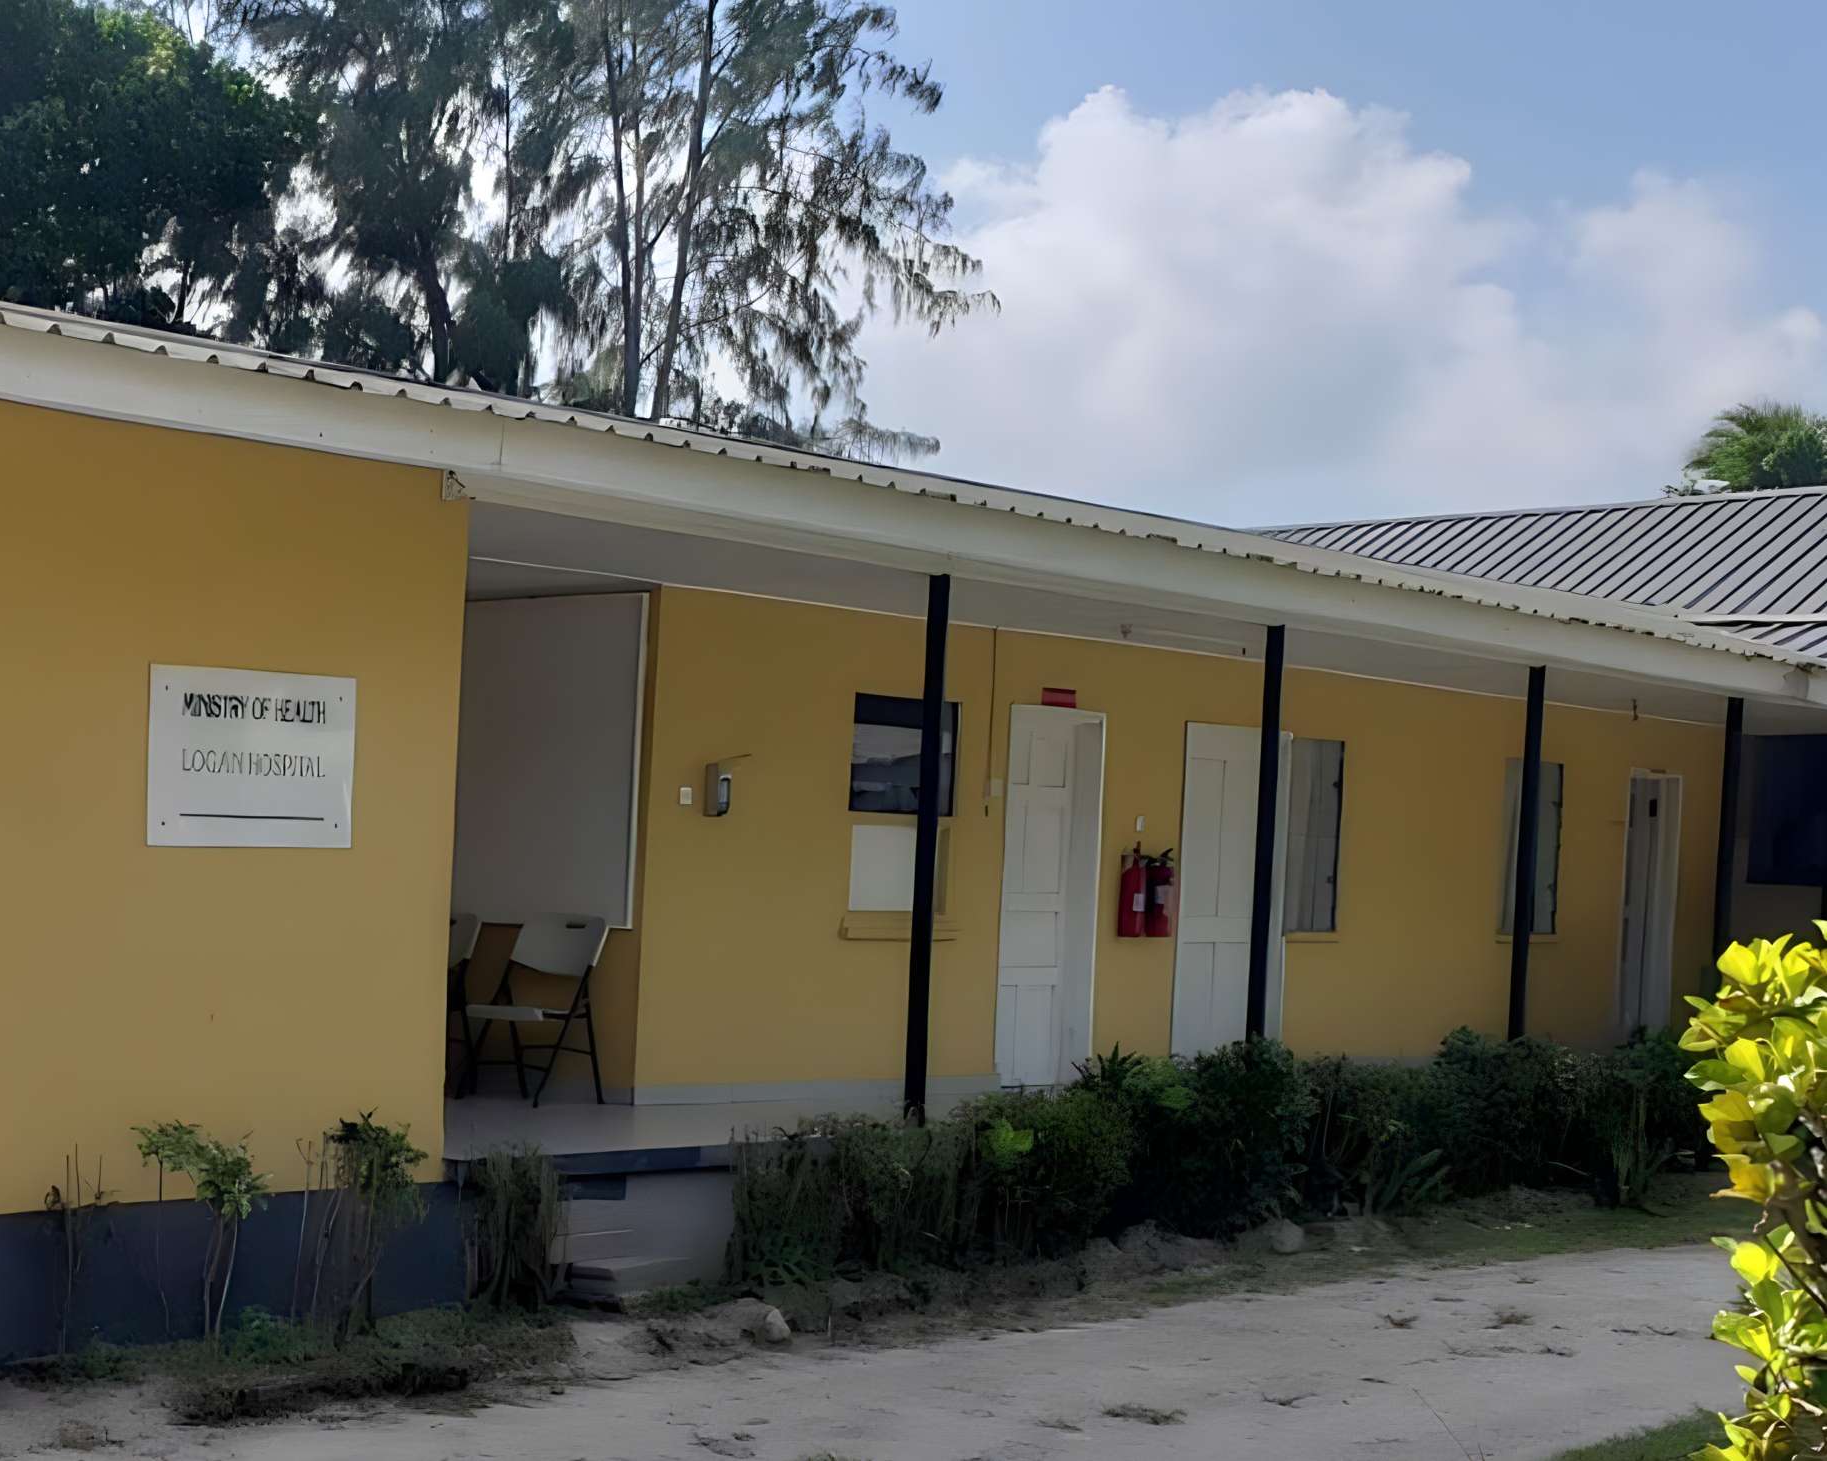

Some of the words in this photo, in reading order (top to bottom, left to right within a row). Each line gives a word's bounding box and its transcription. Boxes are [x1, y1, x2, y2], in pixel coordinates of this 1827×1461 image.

[252, 696, 272, 720] OF
[274, 698, 326, 724] HEALTH
[182, 748, 244, 774] LOGAN
[248, 752, 326, 777] HOSPITAL
